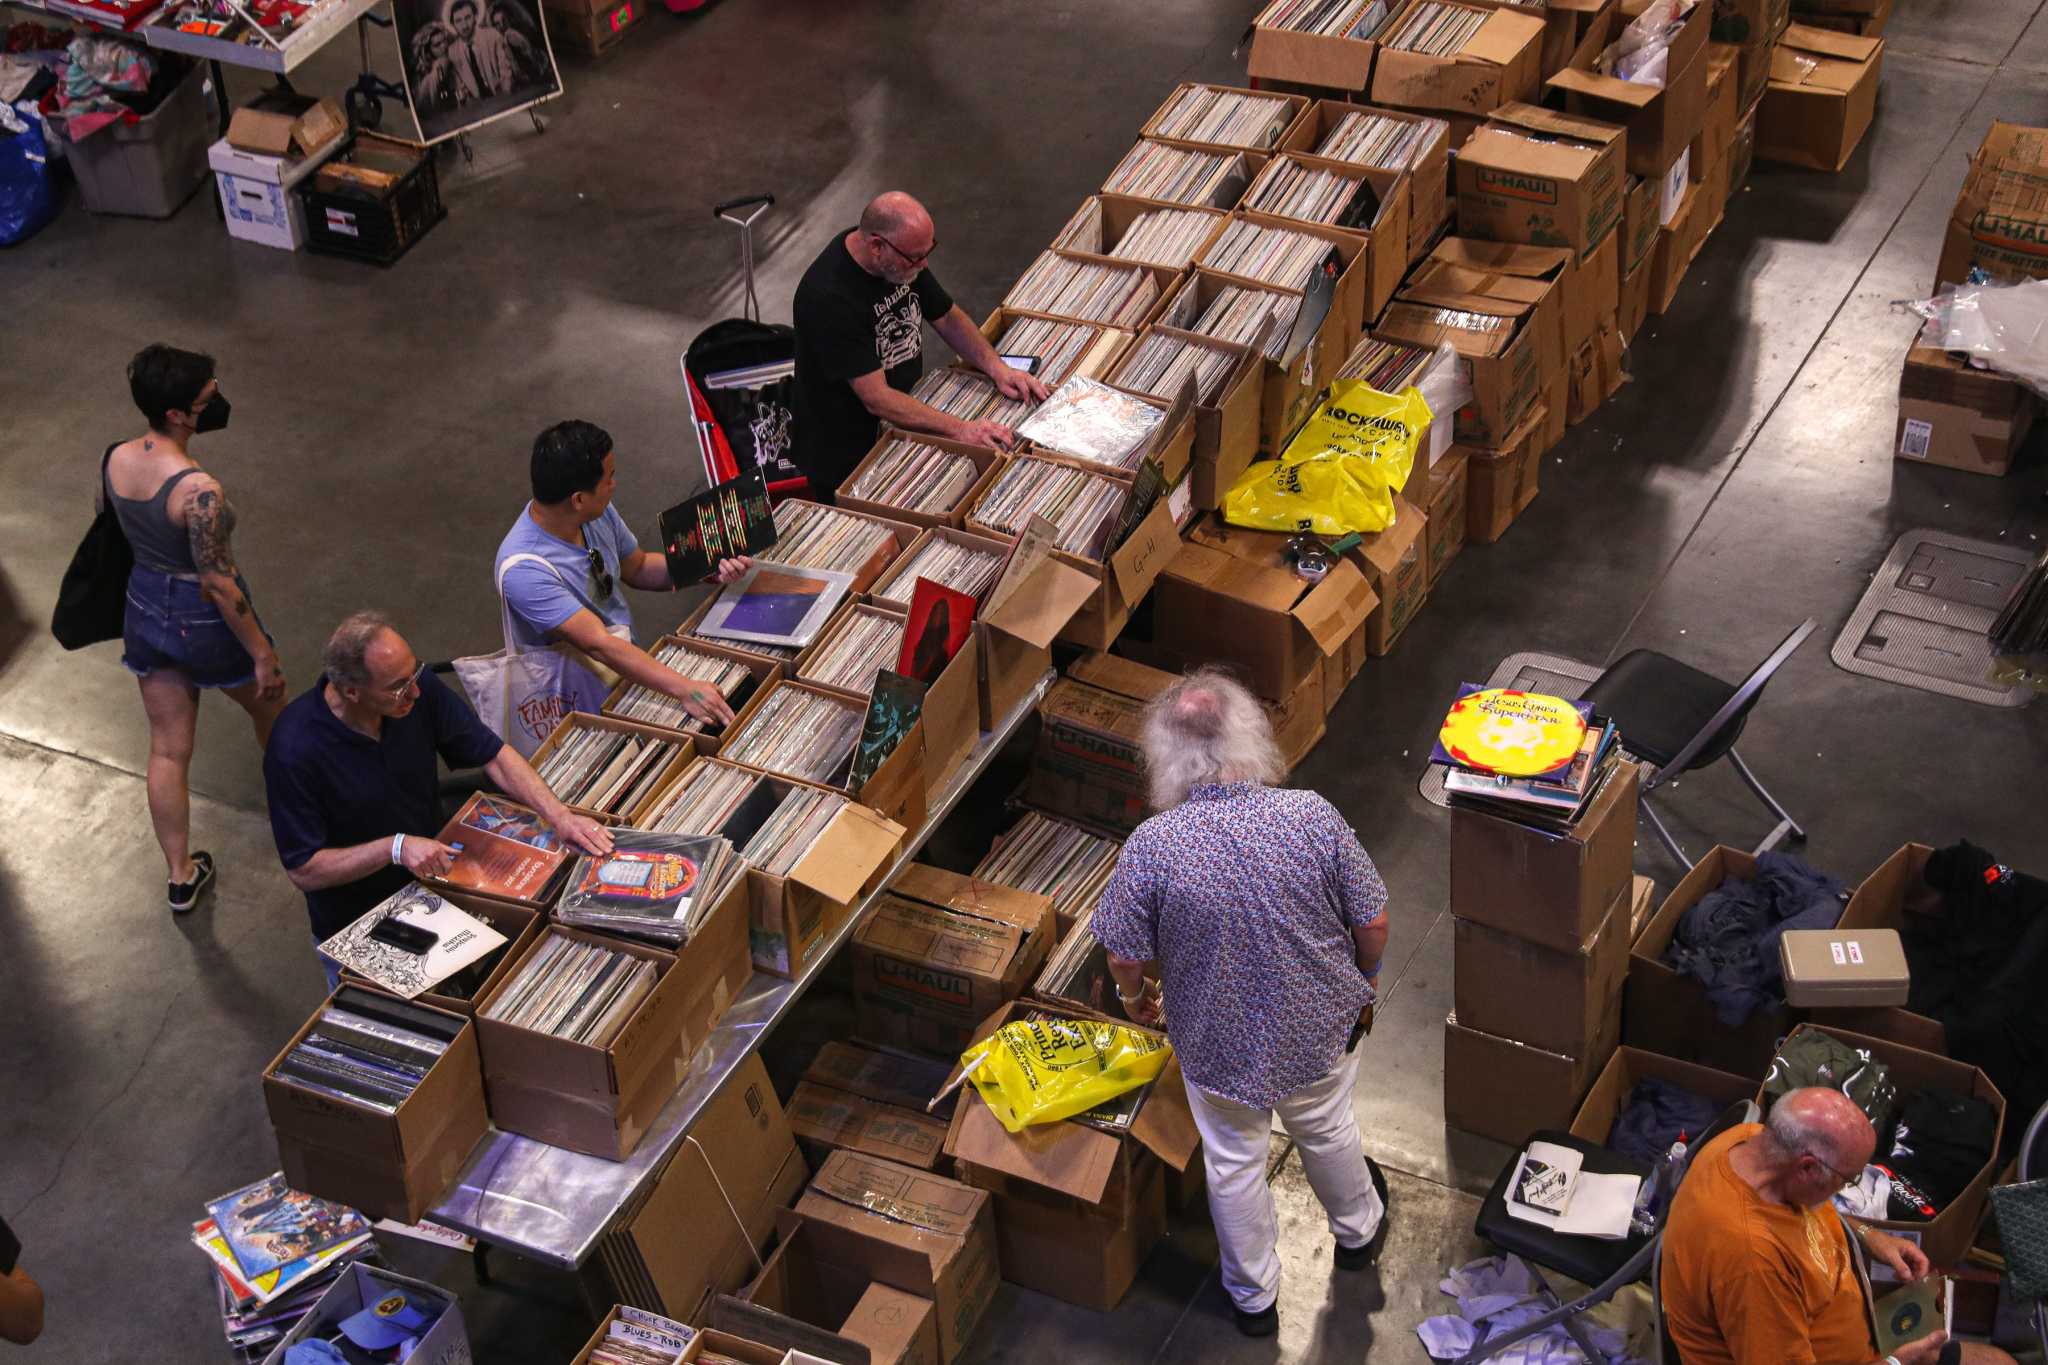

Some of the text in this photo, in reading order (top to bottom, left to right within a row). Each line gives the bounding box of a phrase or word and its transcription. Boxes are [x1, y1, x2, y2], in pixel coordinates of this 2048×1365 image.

[1480, 169, 1551, 194] U-HAUL
[1976, 210, 2048, 245] U-HA
[873, 280, 911, 317] Tehnics
[1026, 1021, 1056, 1061] Princ
[623, 1324, 652, 1339] BLUES
